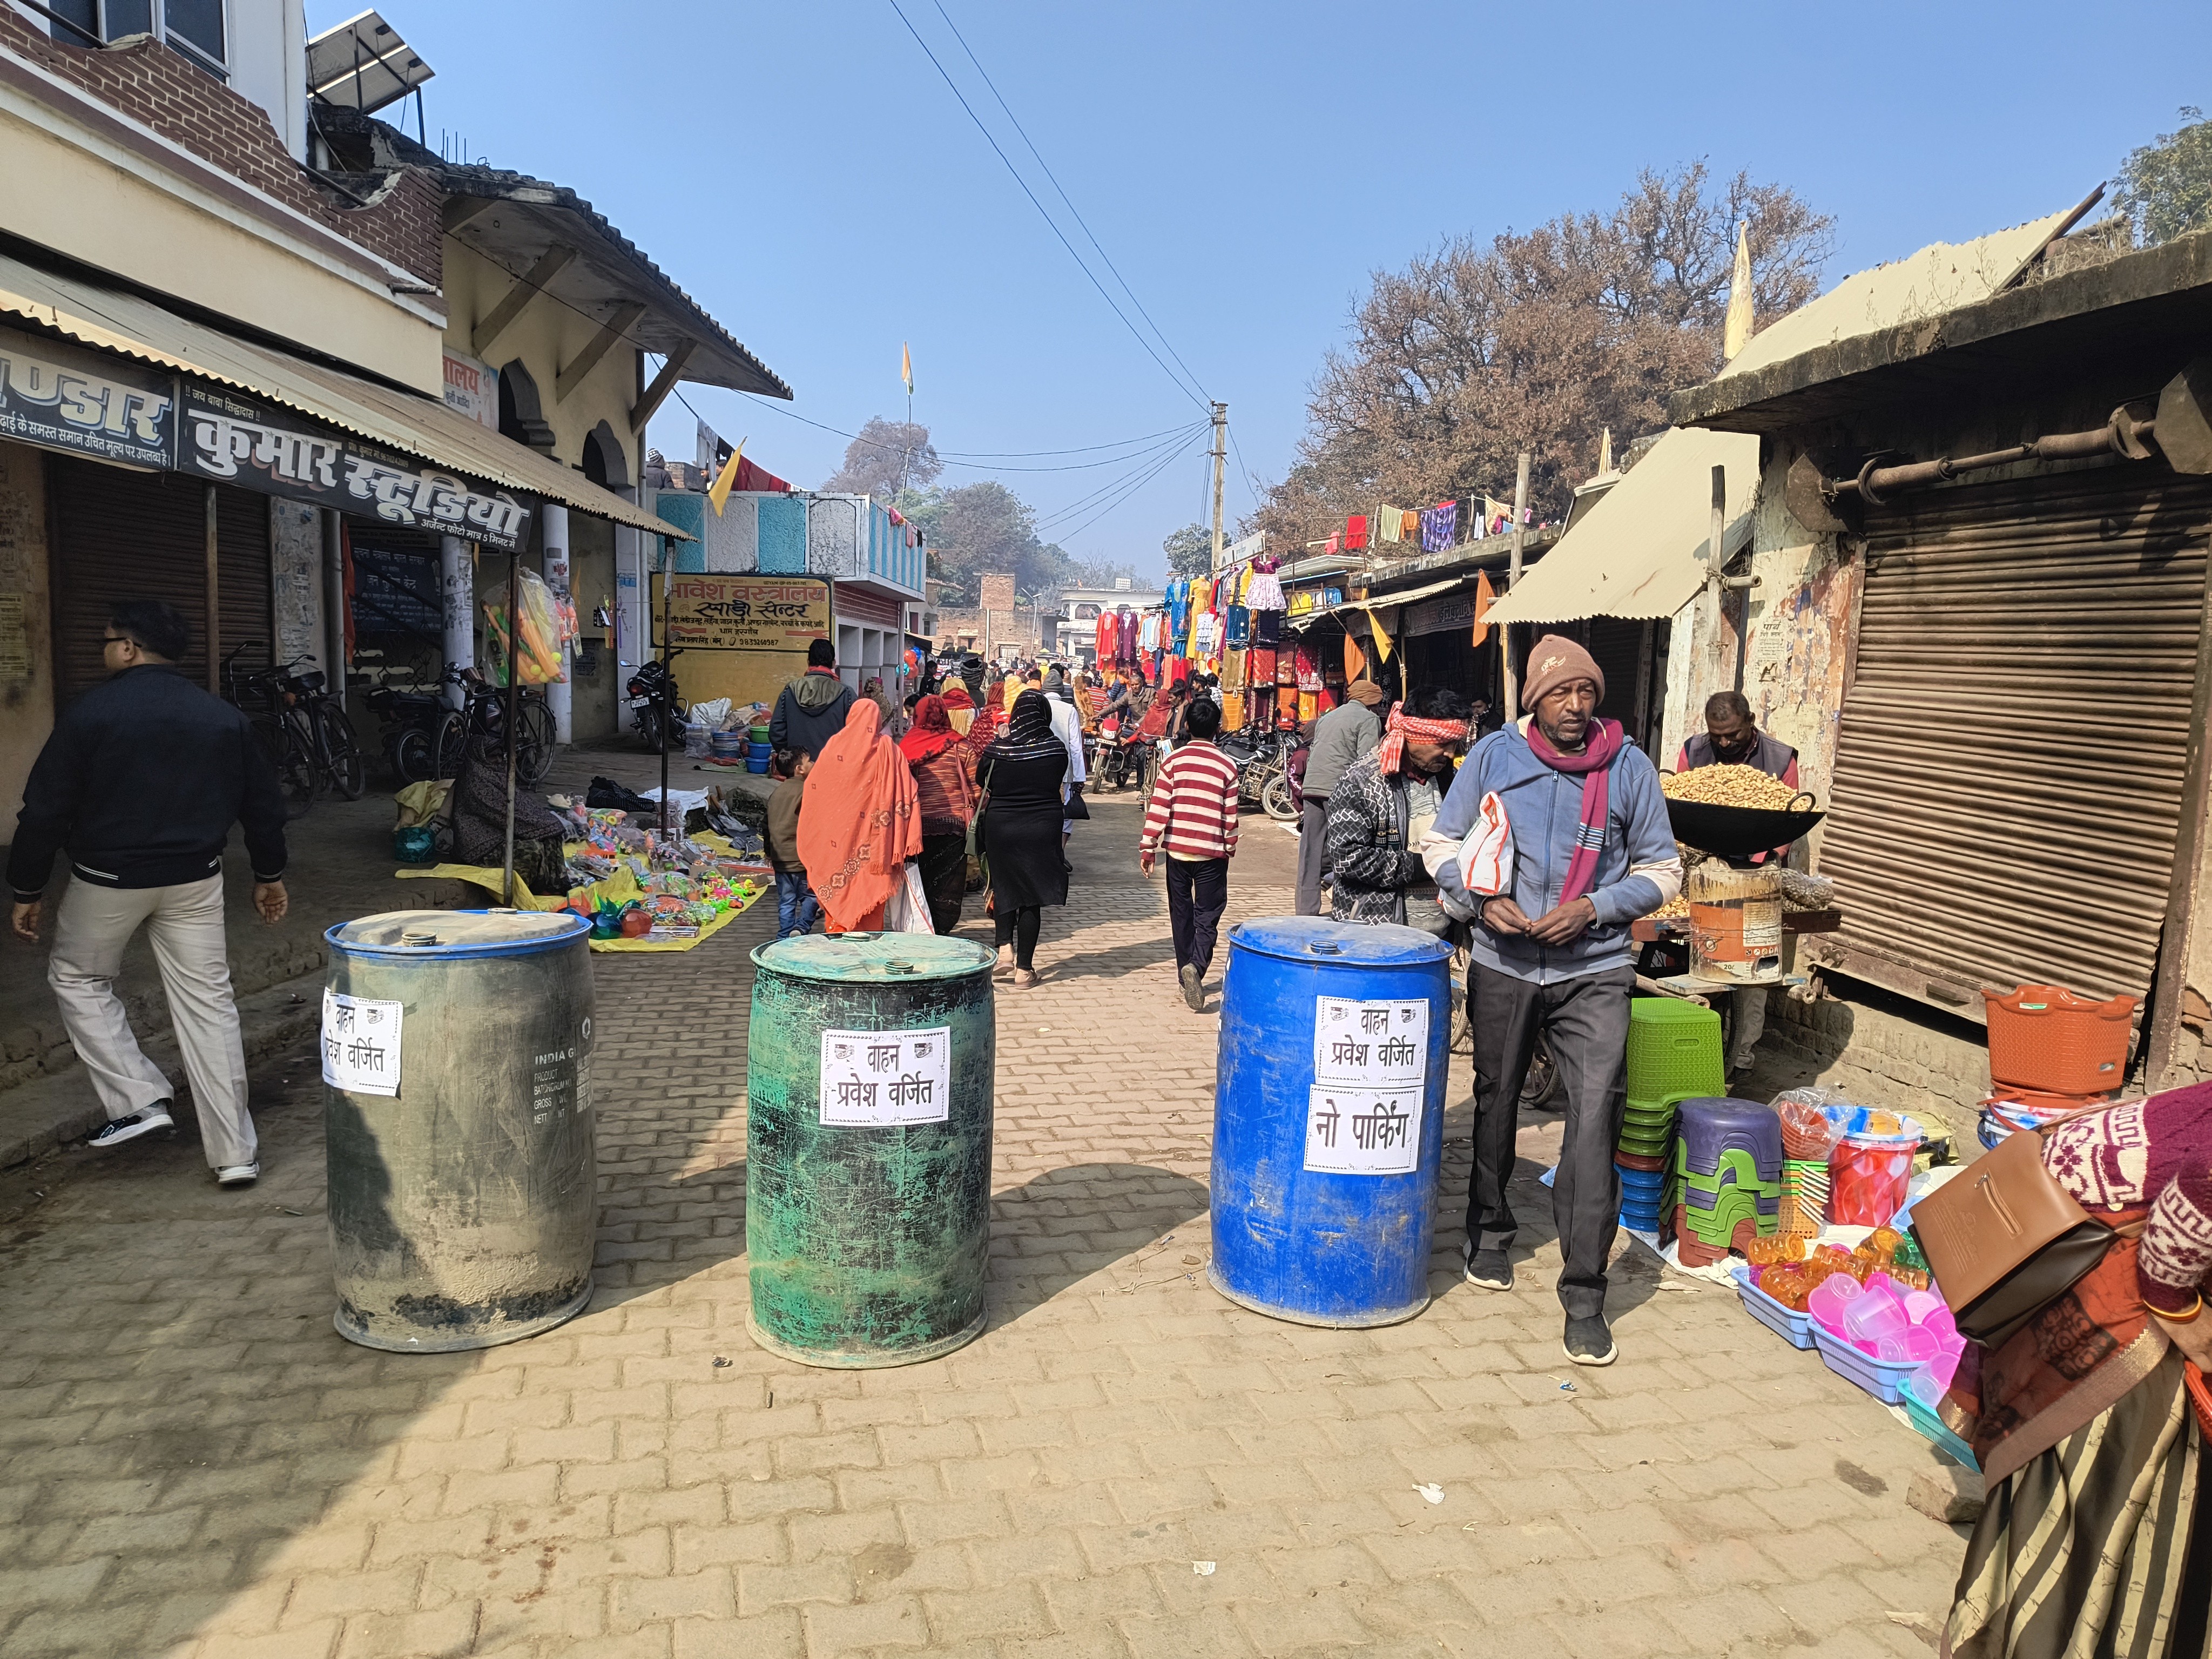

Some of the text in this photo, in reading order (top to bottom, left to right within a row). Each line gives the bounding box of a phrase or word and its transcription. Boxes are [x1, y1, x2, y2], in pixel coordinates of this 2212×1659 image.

[192, 389, 206, 402] जय
[208, 395, 223, 408] बाबा
[17, 414, 26, 431] के
[28, 421, 57, 440] समस्त
[58, 428, 83, 446] समान
[84, 431, 105, 450] उचित
[106, 440, 124, 457] मूल्य
[125, 445, 136, 457] पर
[188, 409, 342, 487] कुमार
[345, 454, 530, 538] स्टूडियो
[421, 518, 446, 531] अर्जेन्ट
[447, 523, 465, 536] फोटो
[466, 529, 482, 541] मात्र
[489, 533, 508, 546] मिनट
[731, 585, 827, 602] वस्त्रालय
[754, 601, 811, 619] सेन्टर
[336, 1004, 355, 1034] वाहन
[1361, 1009, 1390, 1035] वाहन
[348, 1037, 385, 1072] वर्जित
[535, 1050, 565, 1065] INDIA
[867, 1044, 901, 1073] वाहन
[1331, 1035, 1417, 1066] प्रवेश वर्जित
[534, 1068, 558, 1083] PRODUCT
[837, 1071, 934, 1107] प्रवेश वर्जित
[534, 1097, 552, 1110] GROSS
[534, 1112, 548, 1125] NETT
[1316, 1099, 1410, 1150] नो पार्किंग
